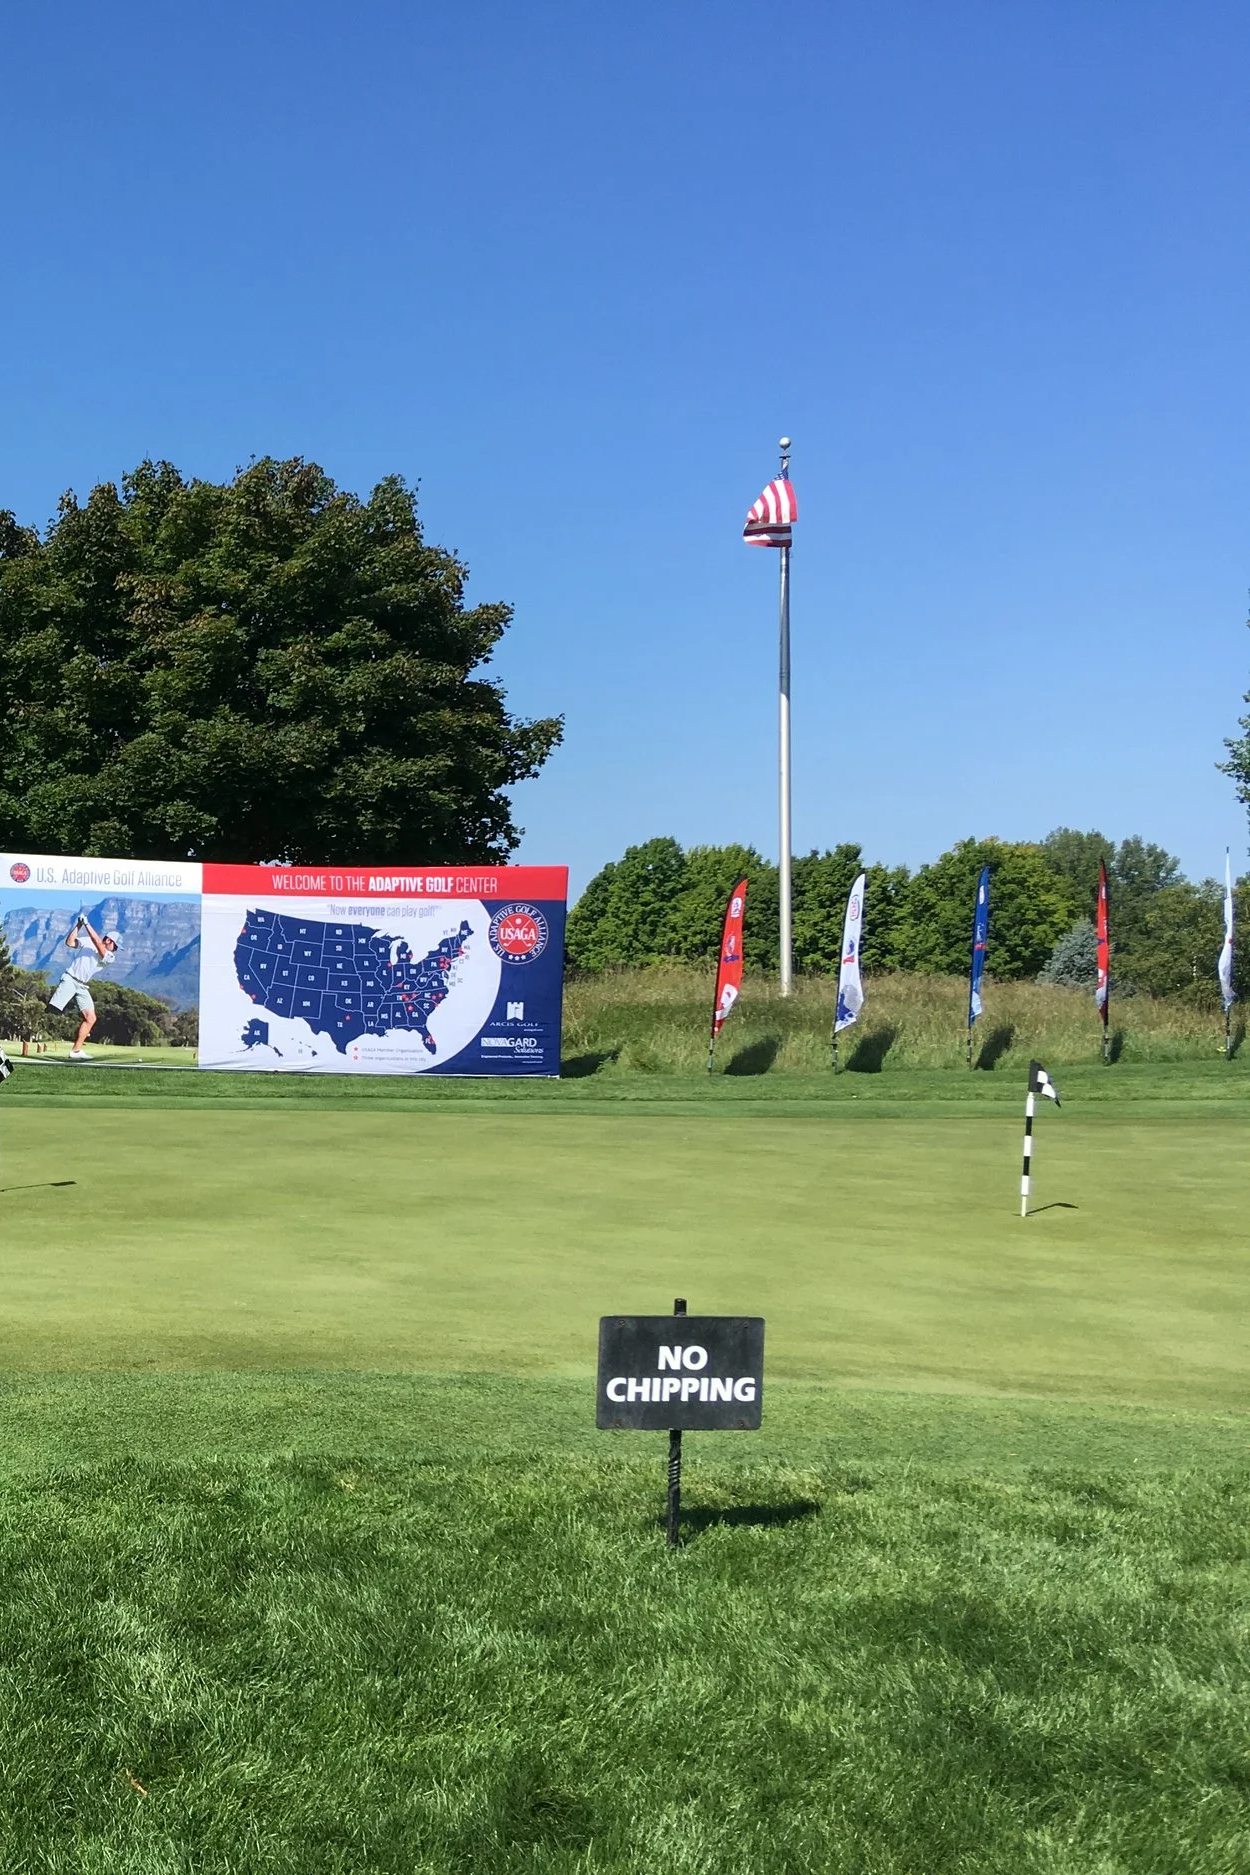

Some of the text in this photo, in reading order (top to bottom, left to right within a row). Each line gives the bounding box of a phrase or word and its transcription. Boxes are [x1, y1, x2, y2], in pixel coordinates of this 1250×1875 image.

[36, 867, 182, 887] U.S. Adaptive Golf Alliance
[272, 875, 498, 893] WELCOME TO THE ADAPTIVE GOLF CENTER
[348, 905, 385, 916] everyone
[387, 907, 400, 917] can
[402, 905, 417, 918] play
[490, 906, 514, 942] ADAPTIVE
[515, 905, 537, 916] GOLF
[529, 916, 547, 957] ALLIANCE
[500, 928, 536, 940] USAGA
[482, 1037, 537, 1047] NOVAGARD
[658, 1345, 708, 1370] NO
[606, 1377, 756, 1402] CHIPPING
